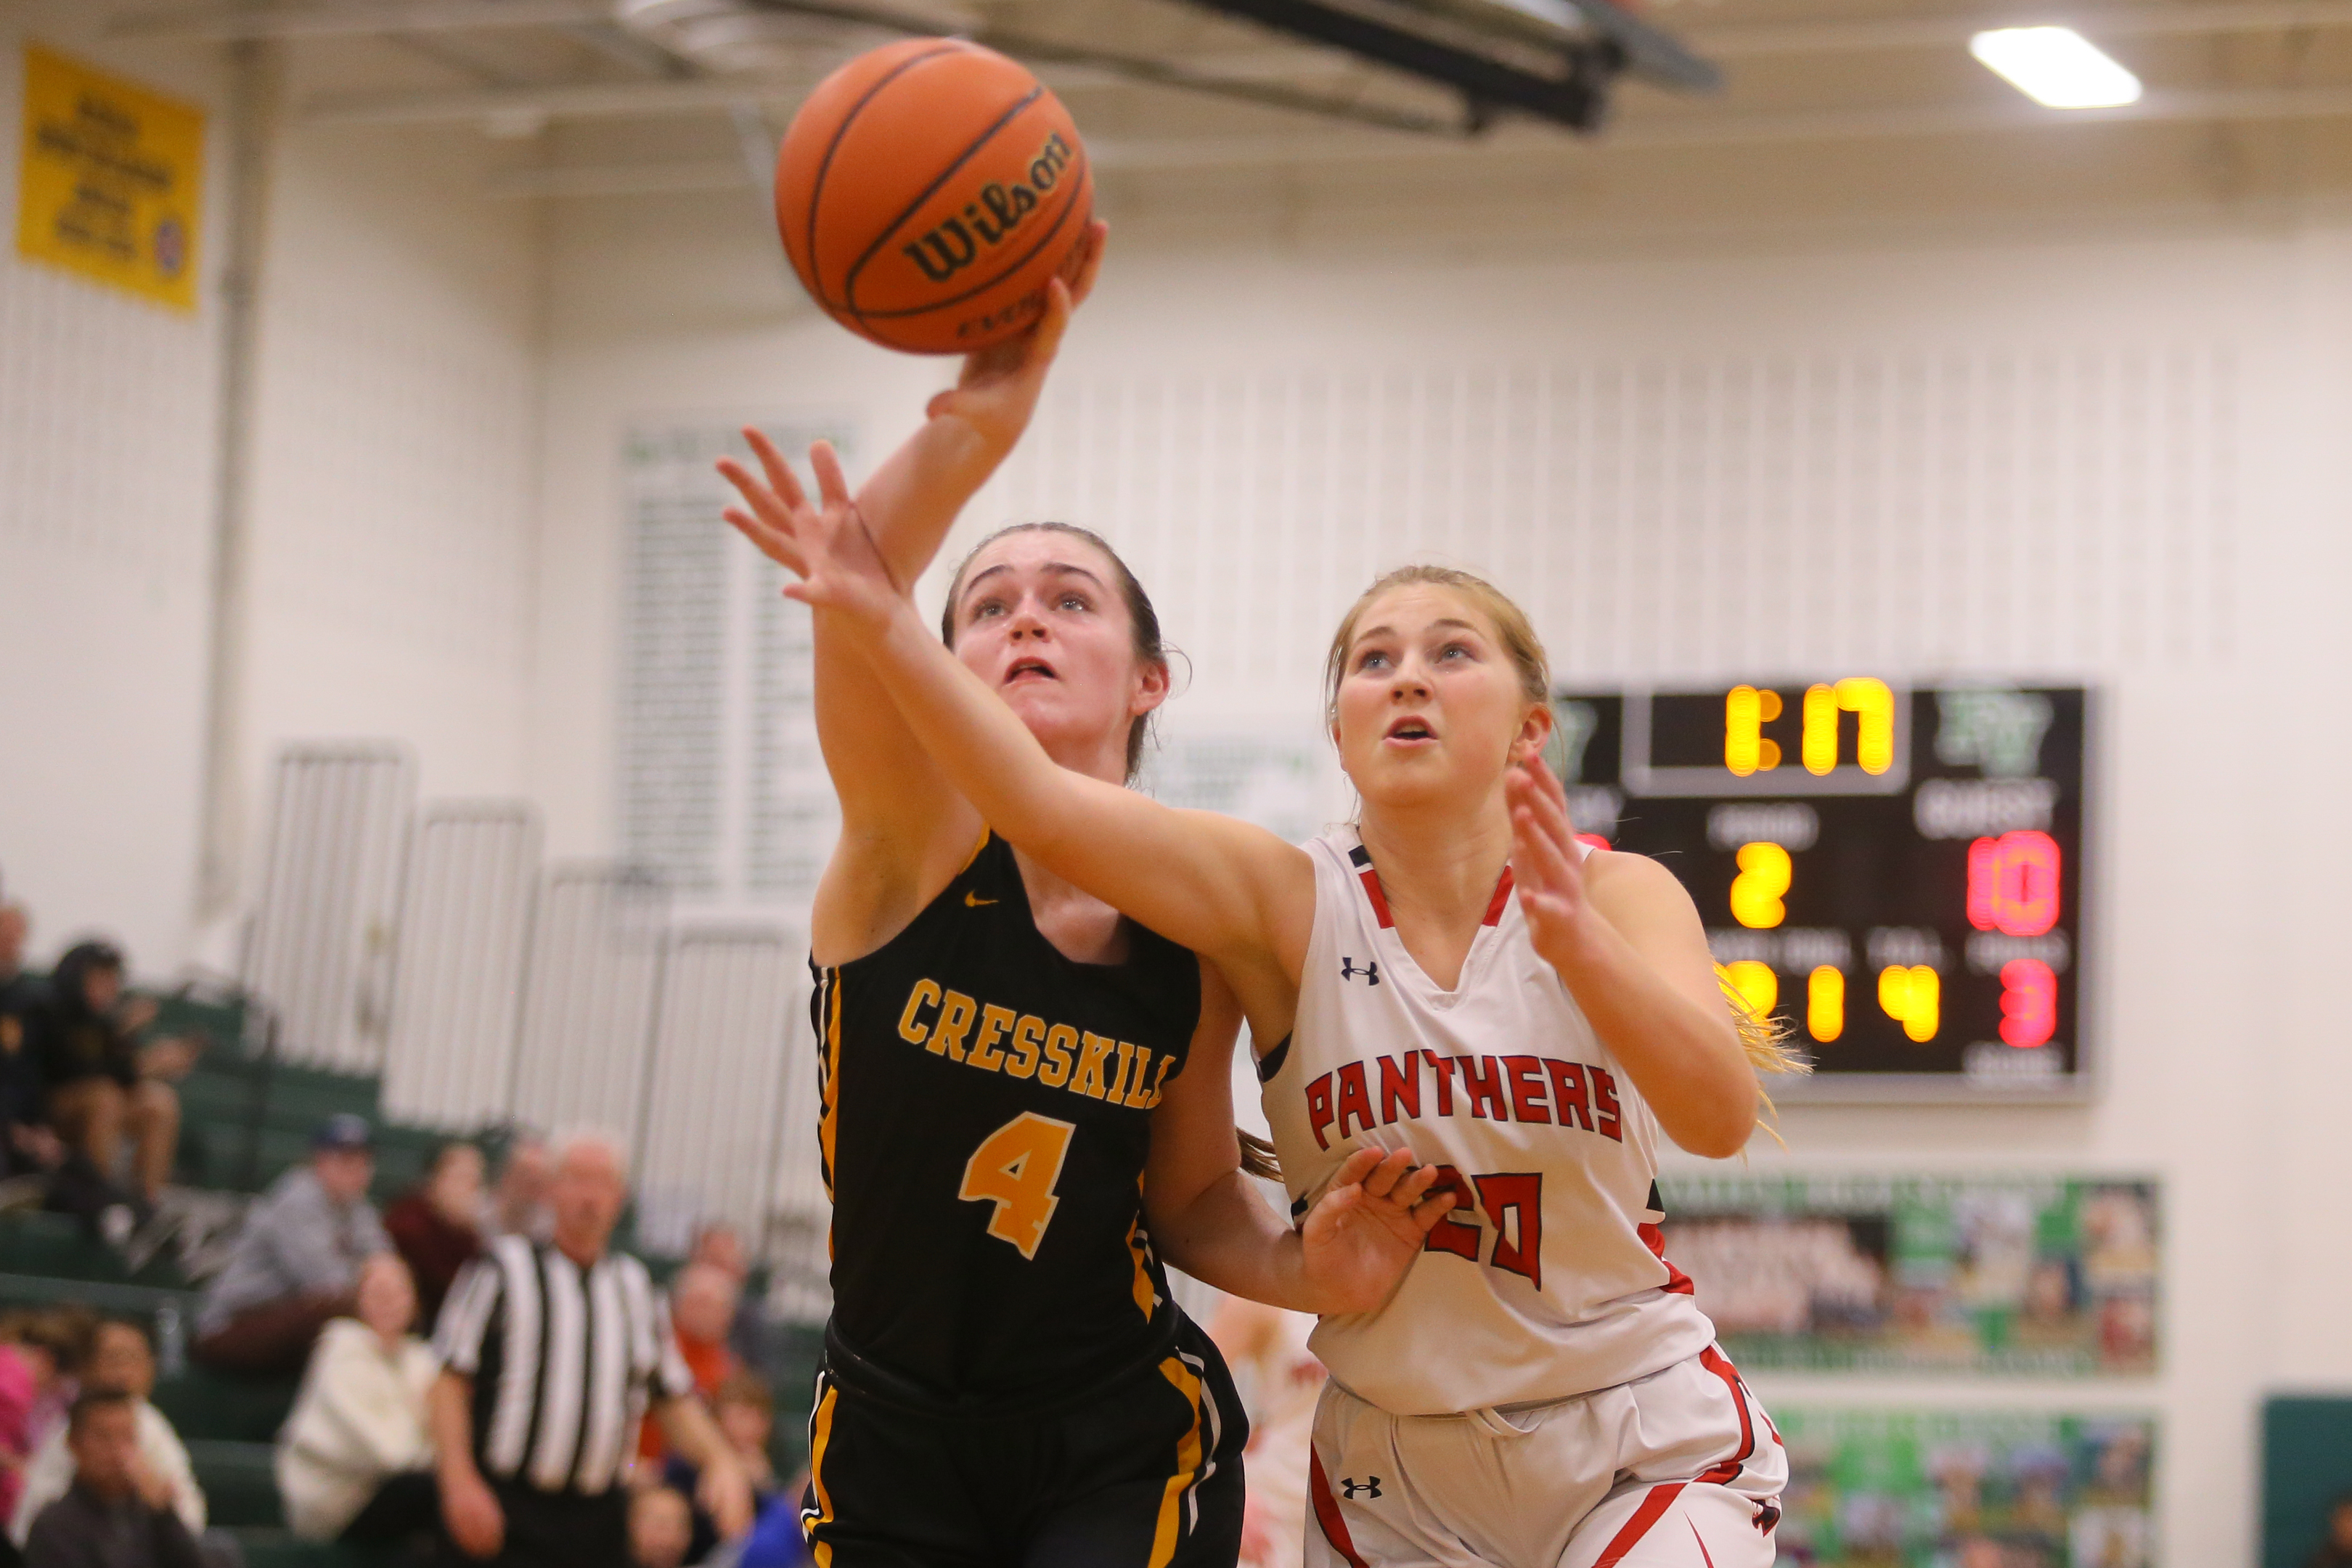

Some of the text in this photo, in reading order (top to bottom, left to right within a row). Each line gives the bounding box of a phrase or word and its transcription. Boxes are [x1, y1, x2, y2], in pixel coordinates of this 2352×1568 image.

[903, 132, 1071, 283] Wilson
[1730, 841, 1792, 928] 2
[1967, 830, 2061, 936] 10
[1998, 958, 2057, 1048] 3
[1305, 1048, 1622, 1151] PANTHERS
[957, 1111, 1077, 1261] 4
